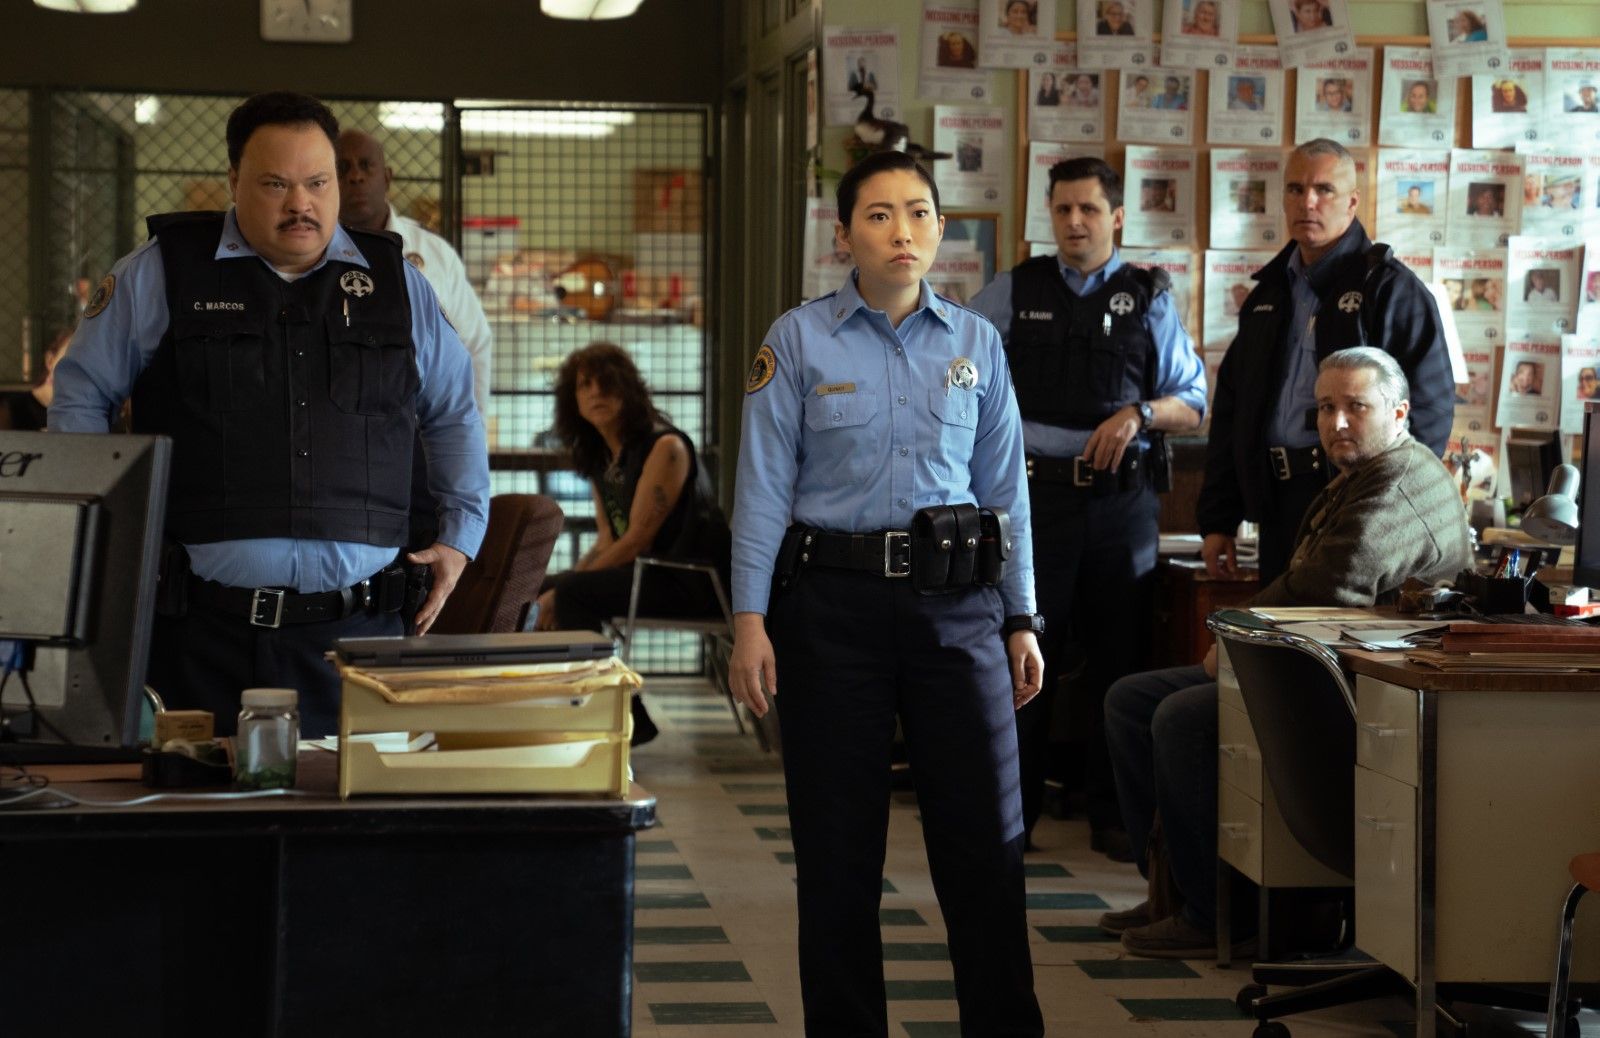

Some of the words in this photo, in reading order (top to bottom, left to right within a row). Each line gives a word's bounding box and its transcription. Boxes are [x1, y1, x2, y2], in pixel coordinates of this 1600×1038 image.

[1390, 59, 1421, 71] MISSING
[1512, 60, 1542, 72] PERSON
[1551, 60, 1585, 71] MISSING
[1385, 160, 1419, 172] MISSING
[1420, 162, 1449, 173] PERSON
[1554, 156, 1583, 167] PERSON
[1457, 162, 1490, 174] MISSING
[1492, 164, 1521, 176] PERSON
[1473, 259, 1503, 270] PERSON
[193, 301, 204, 311] C.
[206, 301, 245, 311] MARCOS
[1532, 343, 1560, 354] PERSON
[0, 451, 43, 478] er
